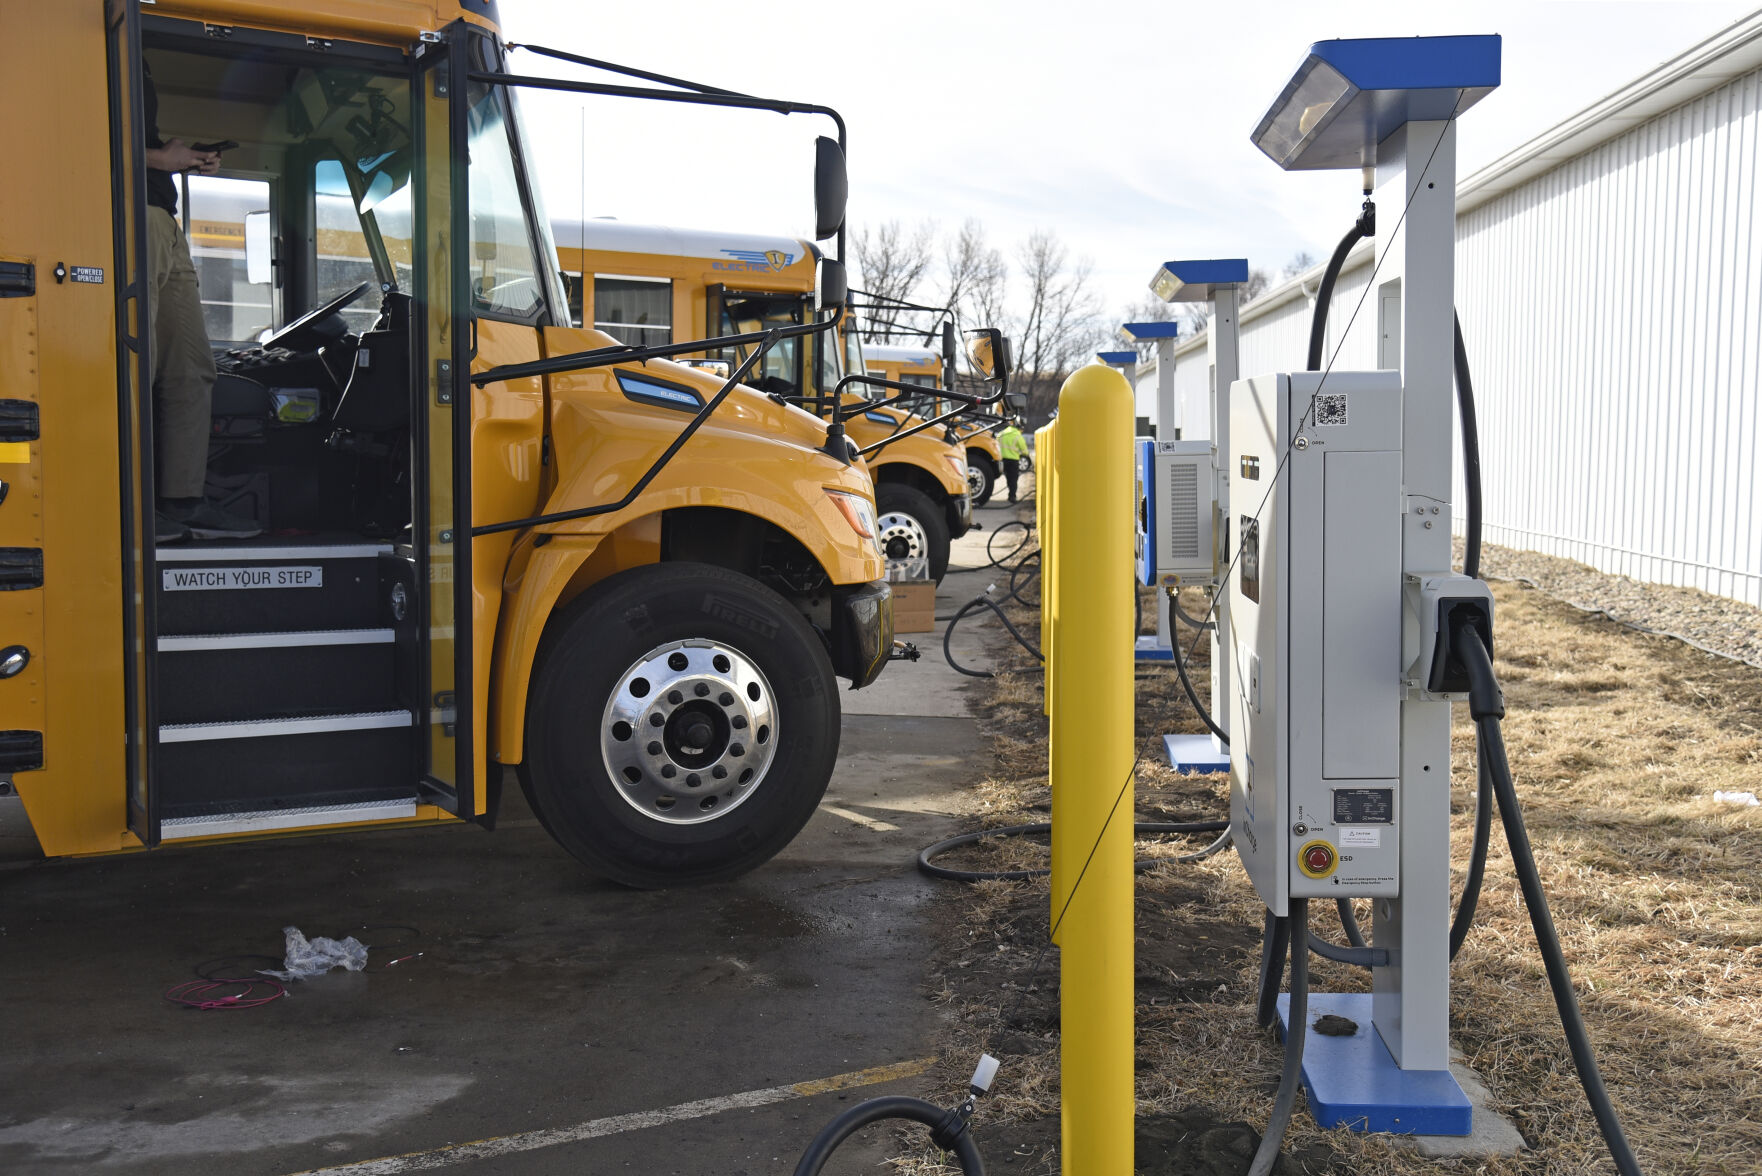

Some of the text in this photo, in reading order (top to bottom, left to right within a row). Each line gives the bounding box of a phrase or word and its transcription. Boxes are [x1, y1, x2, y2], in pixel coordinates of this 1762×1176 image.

[77, 267, 103, 276] POWERED
[712, 262, 770, 273] ELECTRIC
[77, 275, 103, 283] OPEN/CLOSE
[660, 391, 691, 402] ELECTRIC
[174, 571, 313, 587] WATCH YOUR STEP
